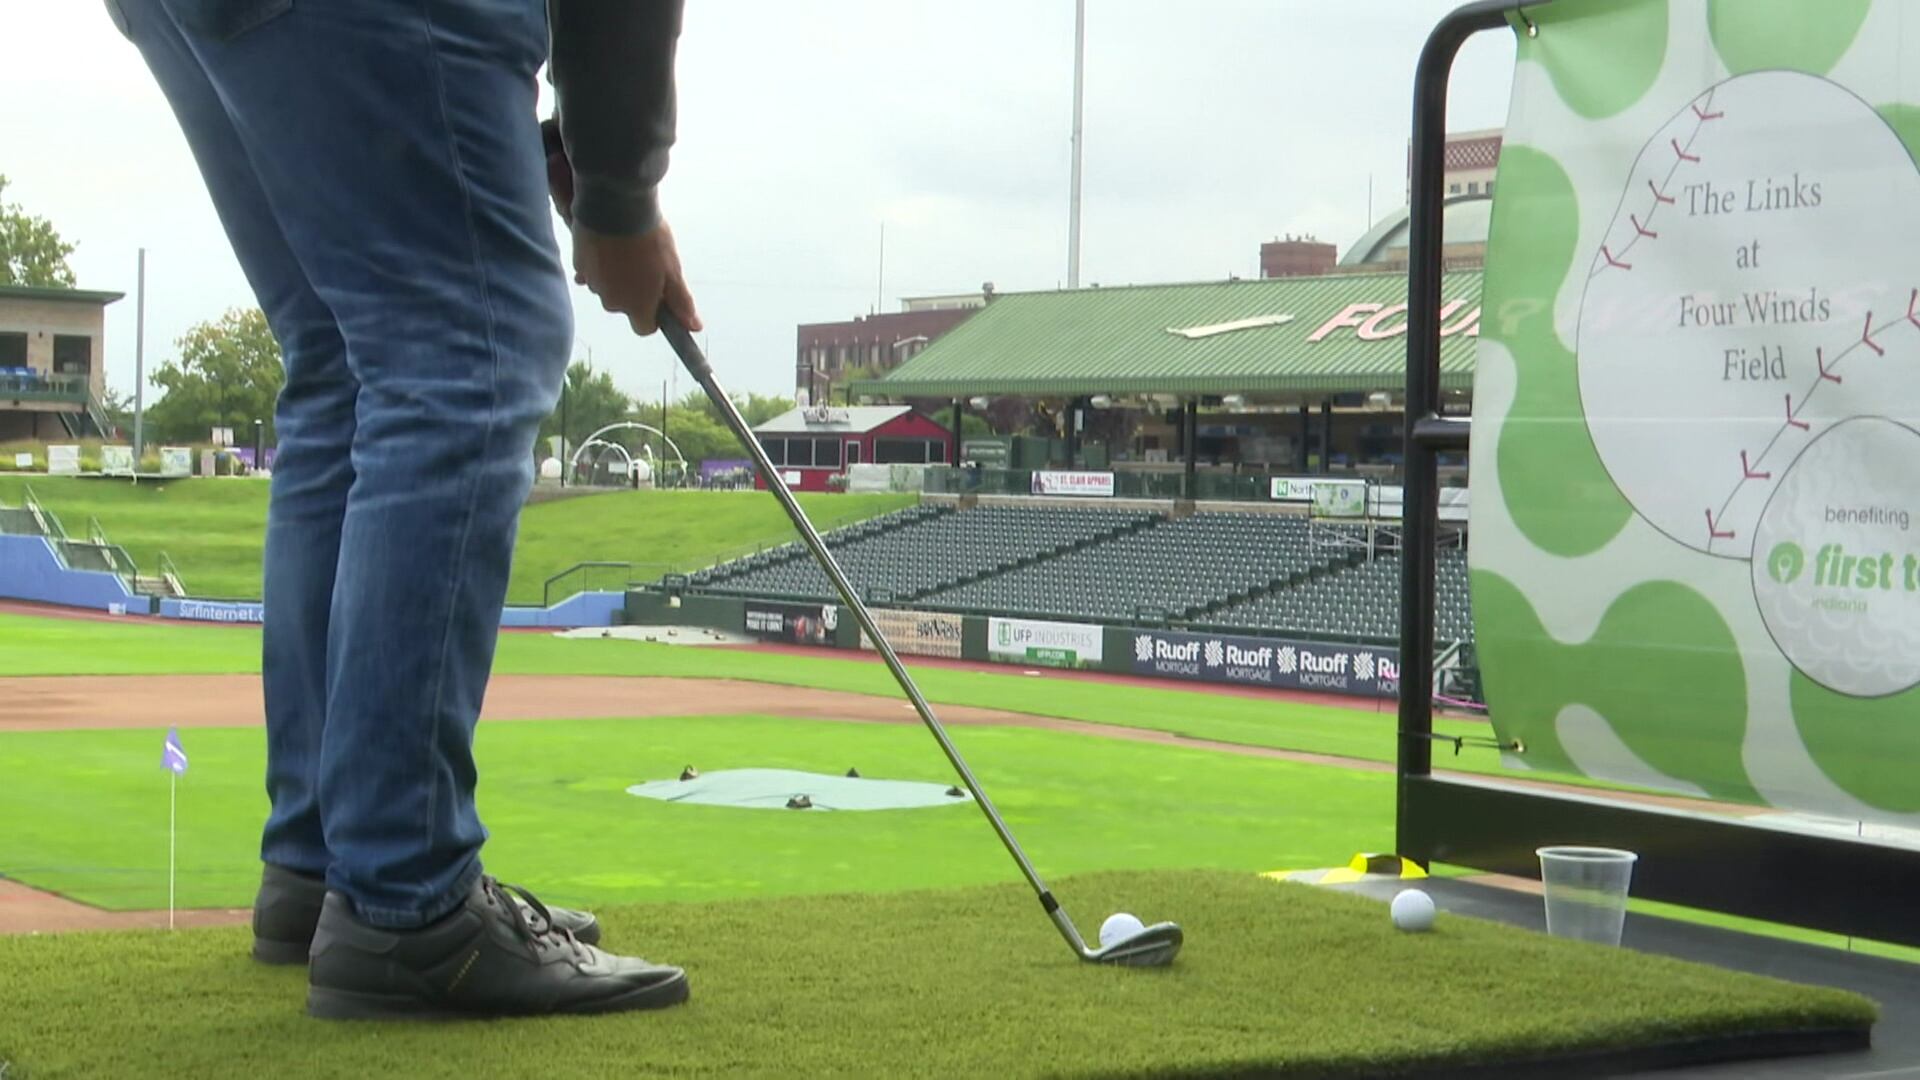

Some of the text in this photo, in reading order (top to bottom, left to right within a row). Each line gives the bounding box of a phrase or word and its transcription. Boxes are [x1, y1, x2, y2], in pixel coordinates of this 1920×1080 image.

[1684, 173, 1822, 216] The Links
[1736, 239, 1760, 269] at
[1678, 287, 1830, 328] Four Winds
[1306, 300, 1481, 344] FOU
[1722, 345, 1787, 381] Field
[1824, 504, 1910, 531] benefiting
[1814, 543, 1920, 592] first t
[1013, 628, 1092, 648] UFP INDUSTRIES
[1156, 639, 1200, 661] Ruoff
[1226, 645, 1272, 668] Ruoff
[1156, 661, 1200, 675] MORTGAGE
[1300, 651, 1348, 674] Ruoff
[1378, 657, 1400, 678] Ru
[1226, 667, 1271, 682] MORTGAGE
[1300, 673, 1348, 689] MORTGAGE
